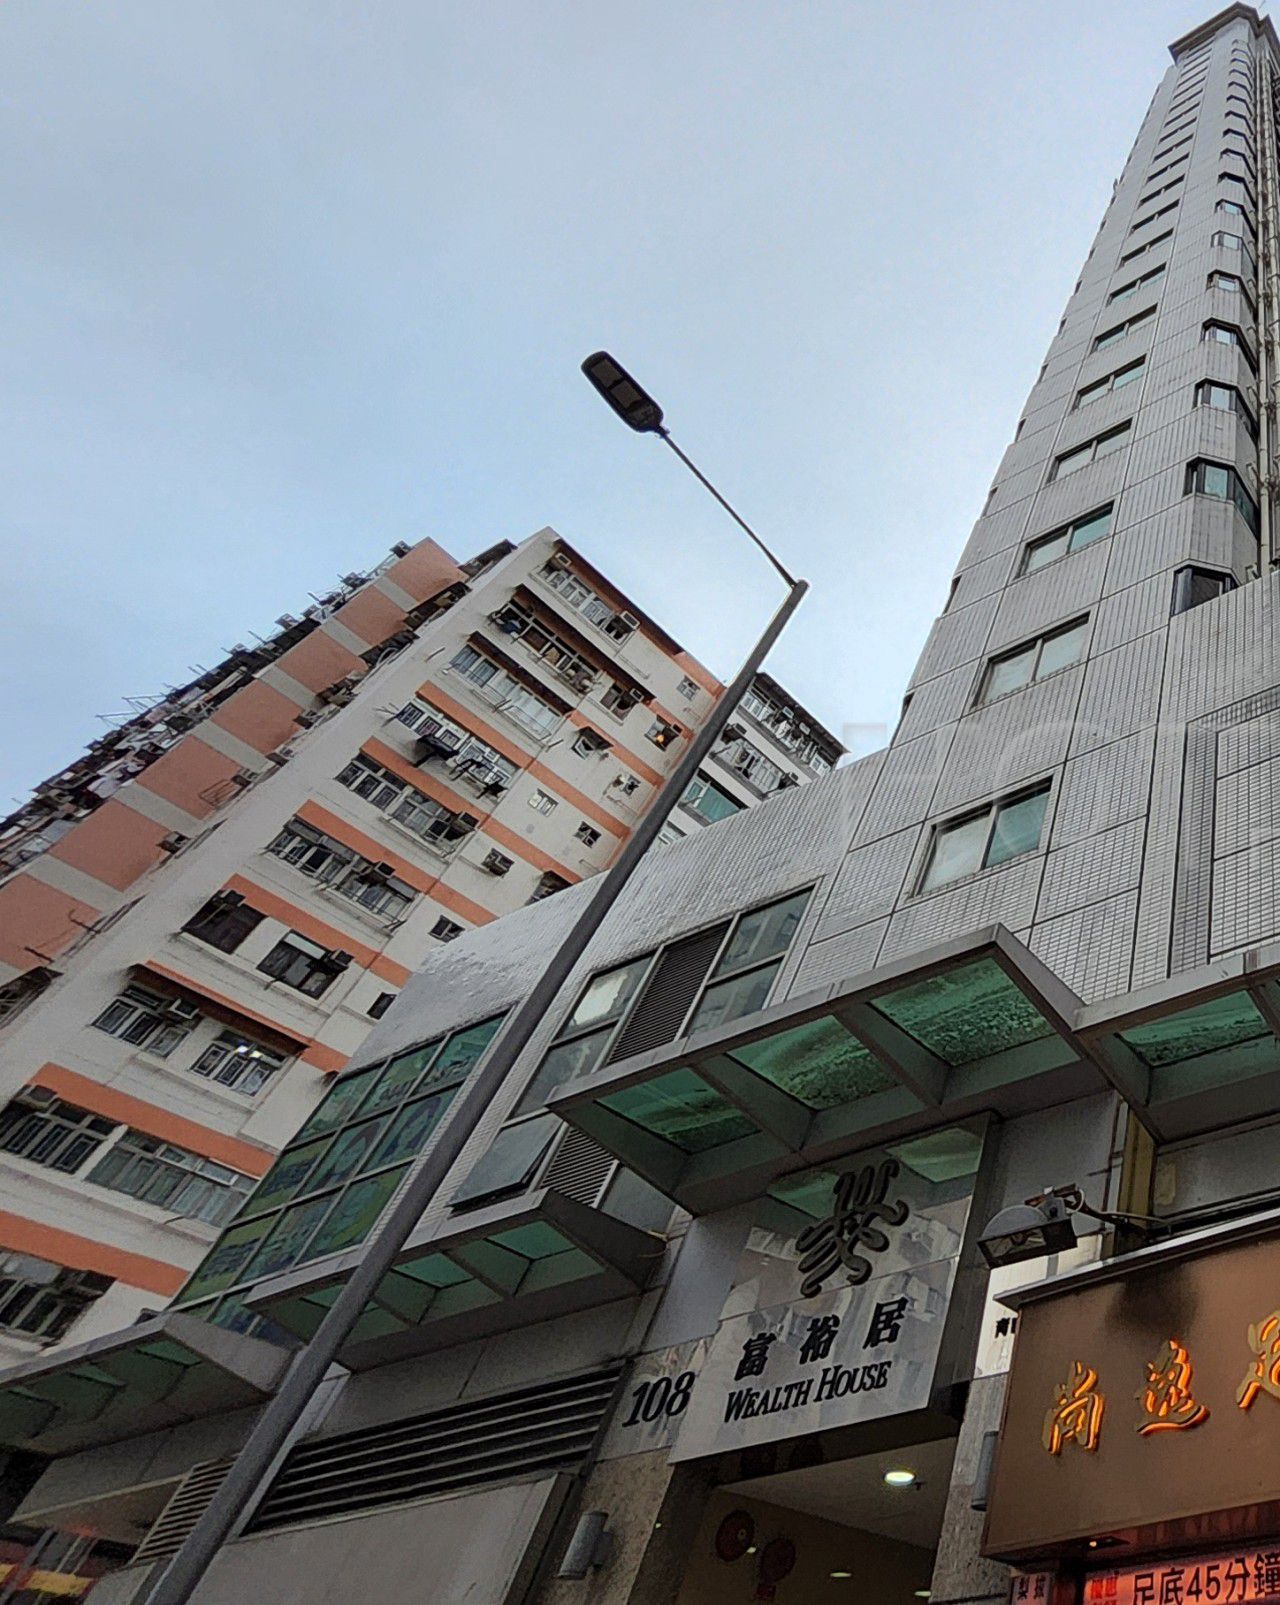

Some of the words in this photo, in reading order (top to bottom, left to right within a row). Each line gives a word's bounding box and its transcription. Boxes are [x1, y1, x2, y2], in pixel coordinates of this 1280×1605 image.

[733, 1296, 909, 1382] 富裕居
[621, 1371, 697, 1428] 108
[723, 1377, 815, 1424] WEALTH
[812, 1360, 893, 1403] HOUSE
